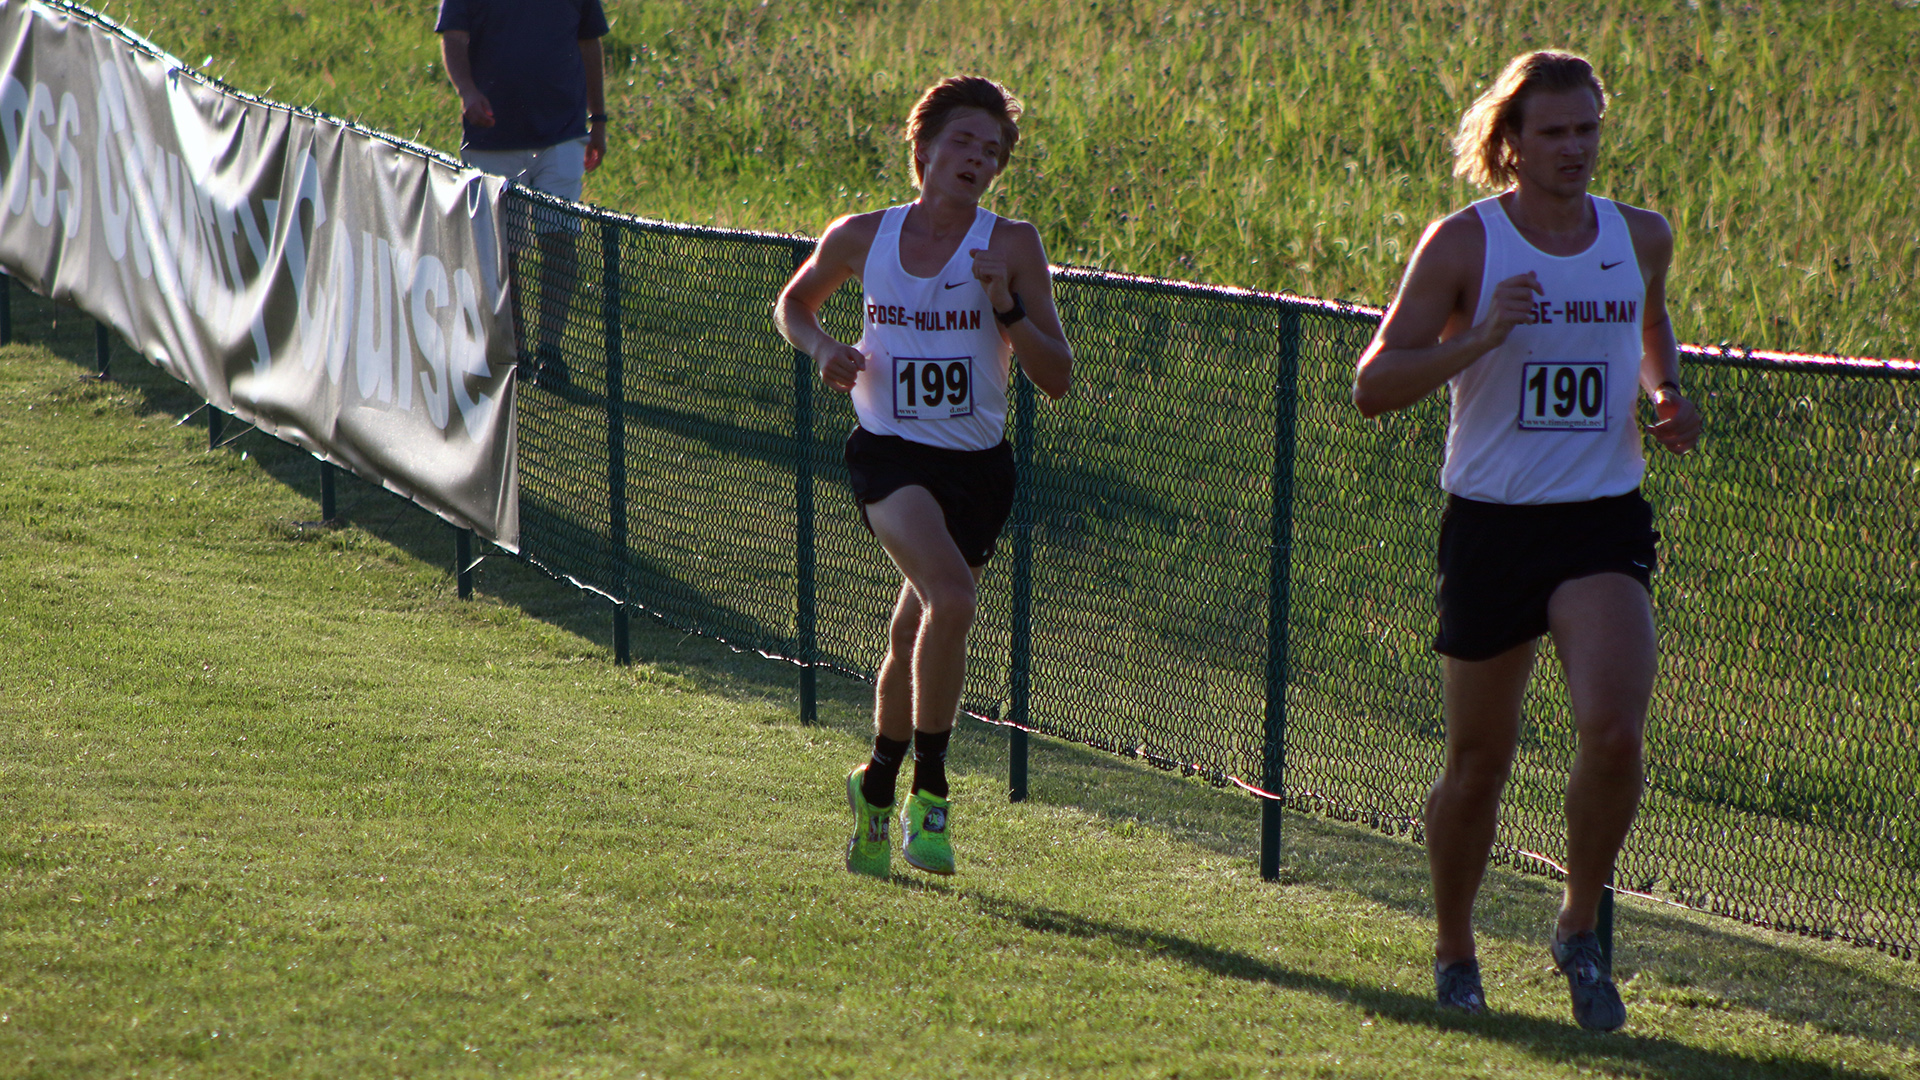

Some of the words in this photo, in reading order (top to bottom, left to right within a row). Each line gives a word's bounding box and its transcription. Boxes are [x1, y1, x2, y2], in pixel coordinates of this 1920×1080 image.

[284, 147, 492, 444] Course
[867, 304, 981, 331] ROSE-HULMAN
[1517, 301, 1637, 324] SE-HULMAN
[899, 361, 969, 407] 199
[1528, 366, 1603, 418] 190
